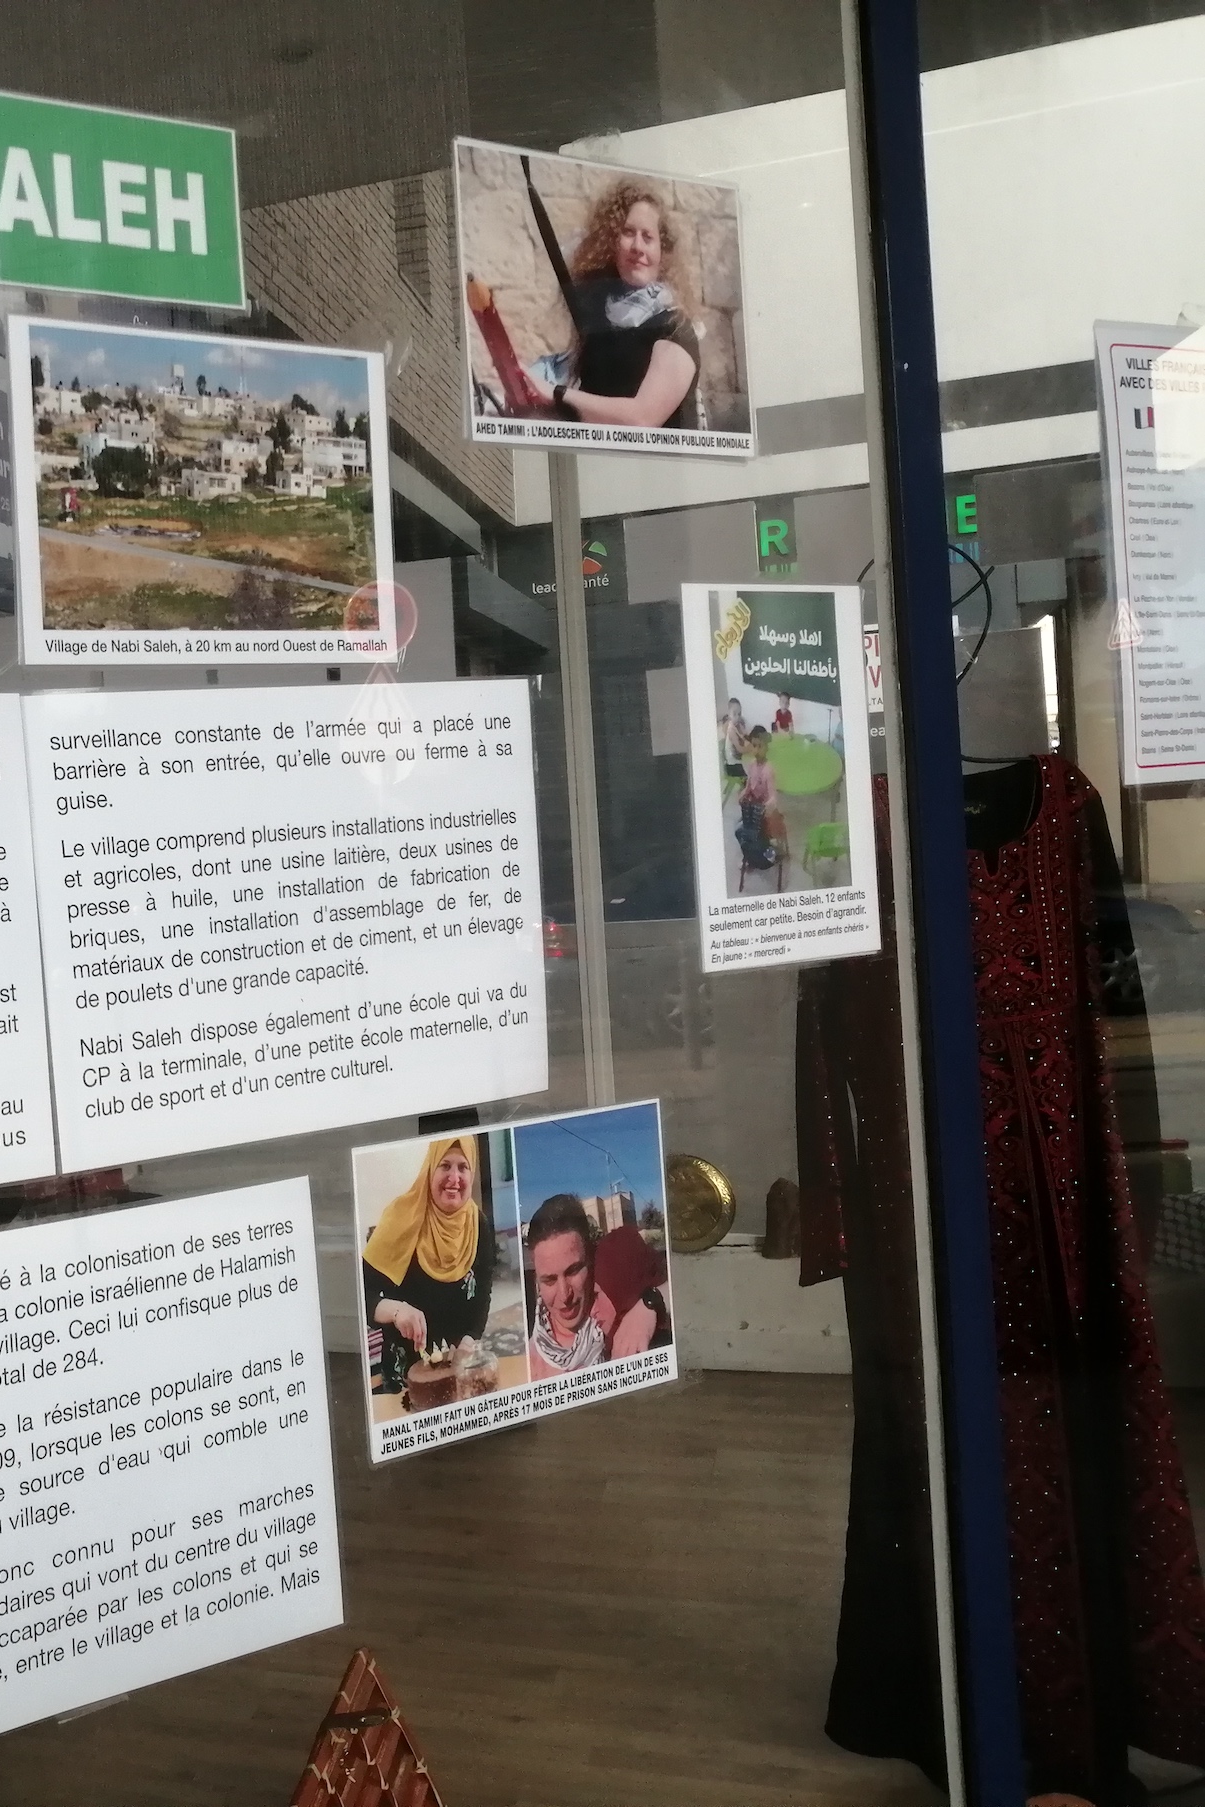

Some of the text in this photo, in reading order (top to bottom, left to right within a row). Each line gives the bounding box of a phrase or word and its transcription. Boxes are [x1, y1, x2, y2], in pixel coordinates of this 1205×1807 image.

[1120, 376, 1146, 389] AVEC
[476, 423, 496, 434] AHED
[498, 424, 525, 436] TAMIMI
[532, 426, 590, 440] L'ADOLESCENTE
[592, 430, 604, 440] QUI
[606, 431, 611, 441] A
[613, 431, 644, 443] CONQUIS
[646, 433, 680, 445] L'OPINION
[682, 436, 714, 447] PUBLIQUE
[716, 438, 749, 449] MONDIALE
[45, 639, 387, 656] Village de Nabi Saleh, à 20 km au nord Ouest de Ramallah
[759, 625, 796, 647] وسهلا
[744, 657, 837, 683] بأطفالنا الحلوين
[50, 712, 511, 750] surveillance constante de l'armée qui a placé une
[708, 890, 865, 916] La maternelle de Nabi Saleh. 12 enfants
[710, 905, 866, 932] seulement car petite. Besoin d'agrandir.
[19, 1266, 32, 1287] à
[40, 1264, 56, 1283] la
[64, 1243, 175, 1278] colonisation
[183, 1235, 204, 1254] de
[212, 1231, 240, 1249] ses
[247, 1220, 293, 1242] terres
[17, 1414, 34, 1434] la
[44, 1392, 140, 1427] résistance
[151, 1368, 232, 1408] populaire
[242, 1358, 282, 1379] dans
[290, 1350, 304, 1368] le
[382, 1352, 668, 1439] MANAL TAMIMI FAIT UN GÂTEAU POUR FÊTER LA LIBÉRATION DE L'UN DE SES
